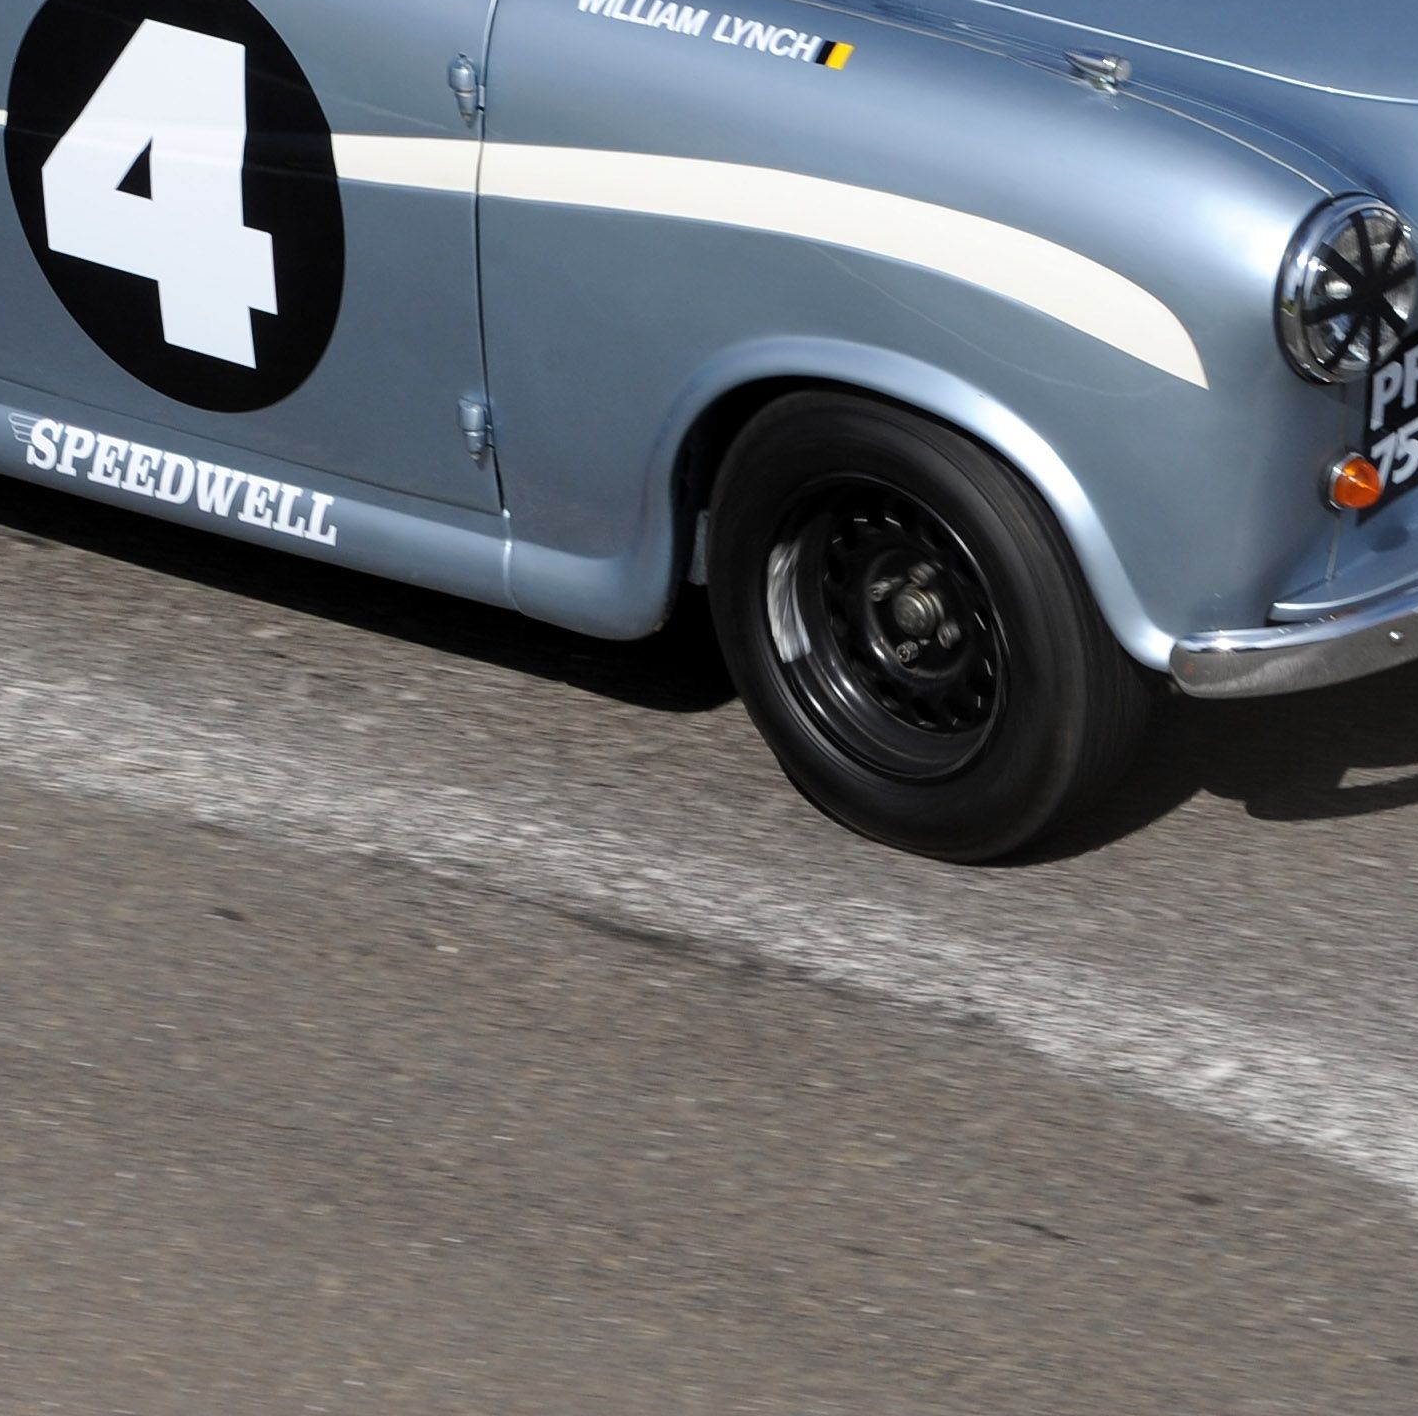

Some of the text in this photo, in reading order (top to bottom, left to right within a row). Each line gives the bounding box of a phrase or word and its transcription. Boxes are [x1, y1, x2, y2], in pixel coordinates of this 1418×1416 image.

[712, 15, 822, 64] LYNCH
[41, 18, 278, 369] 4
[26, 418, 338, 546] SPEEDWELL
